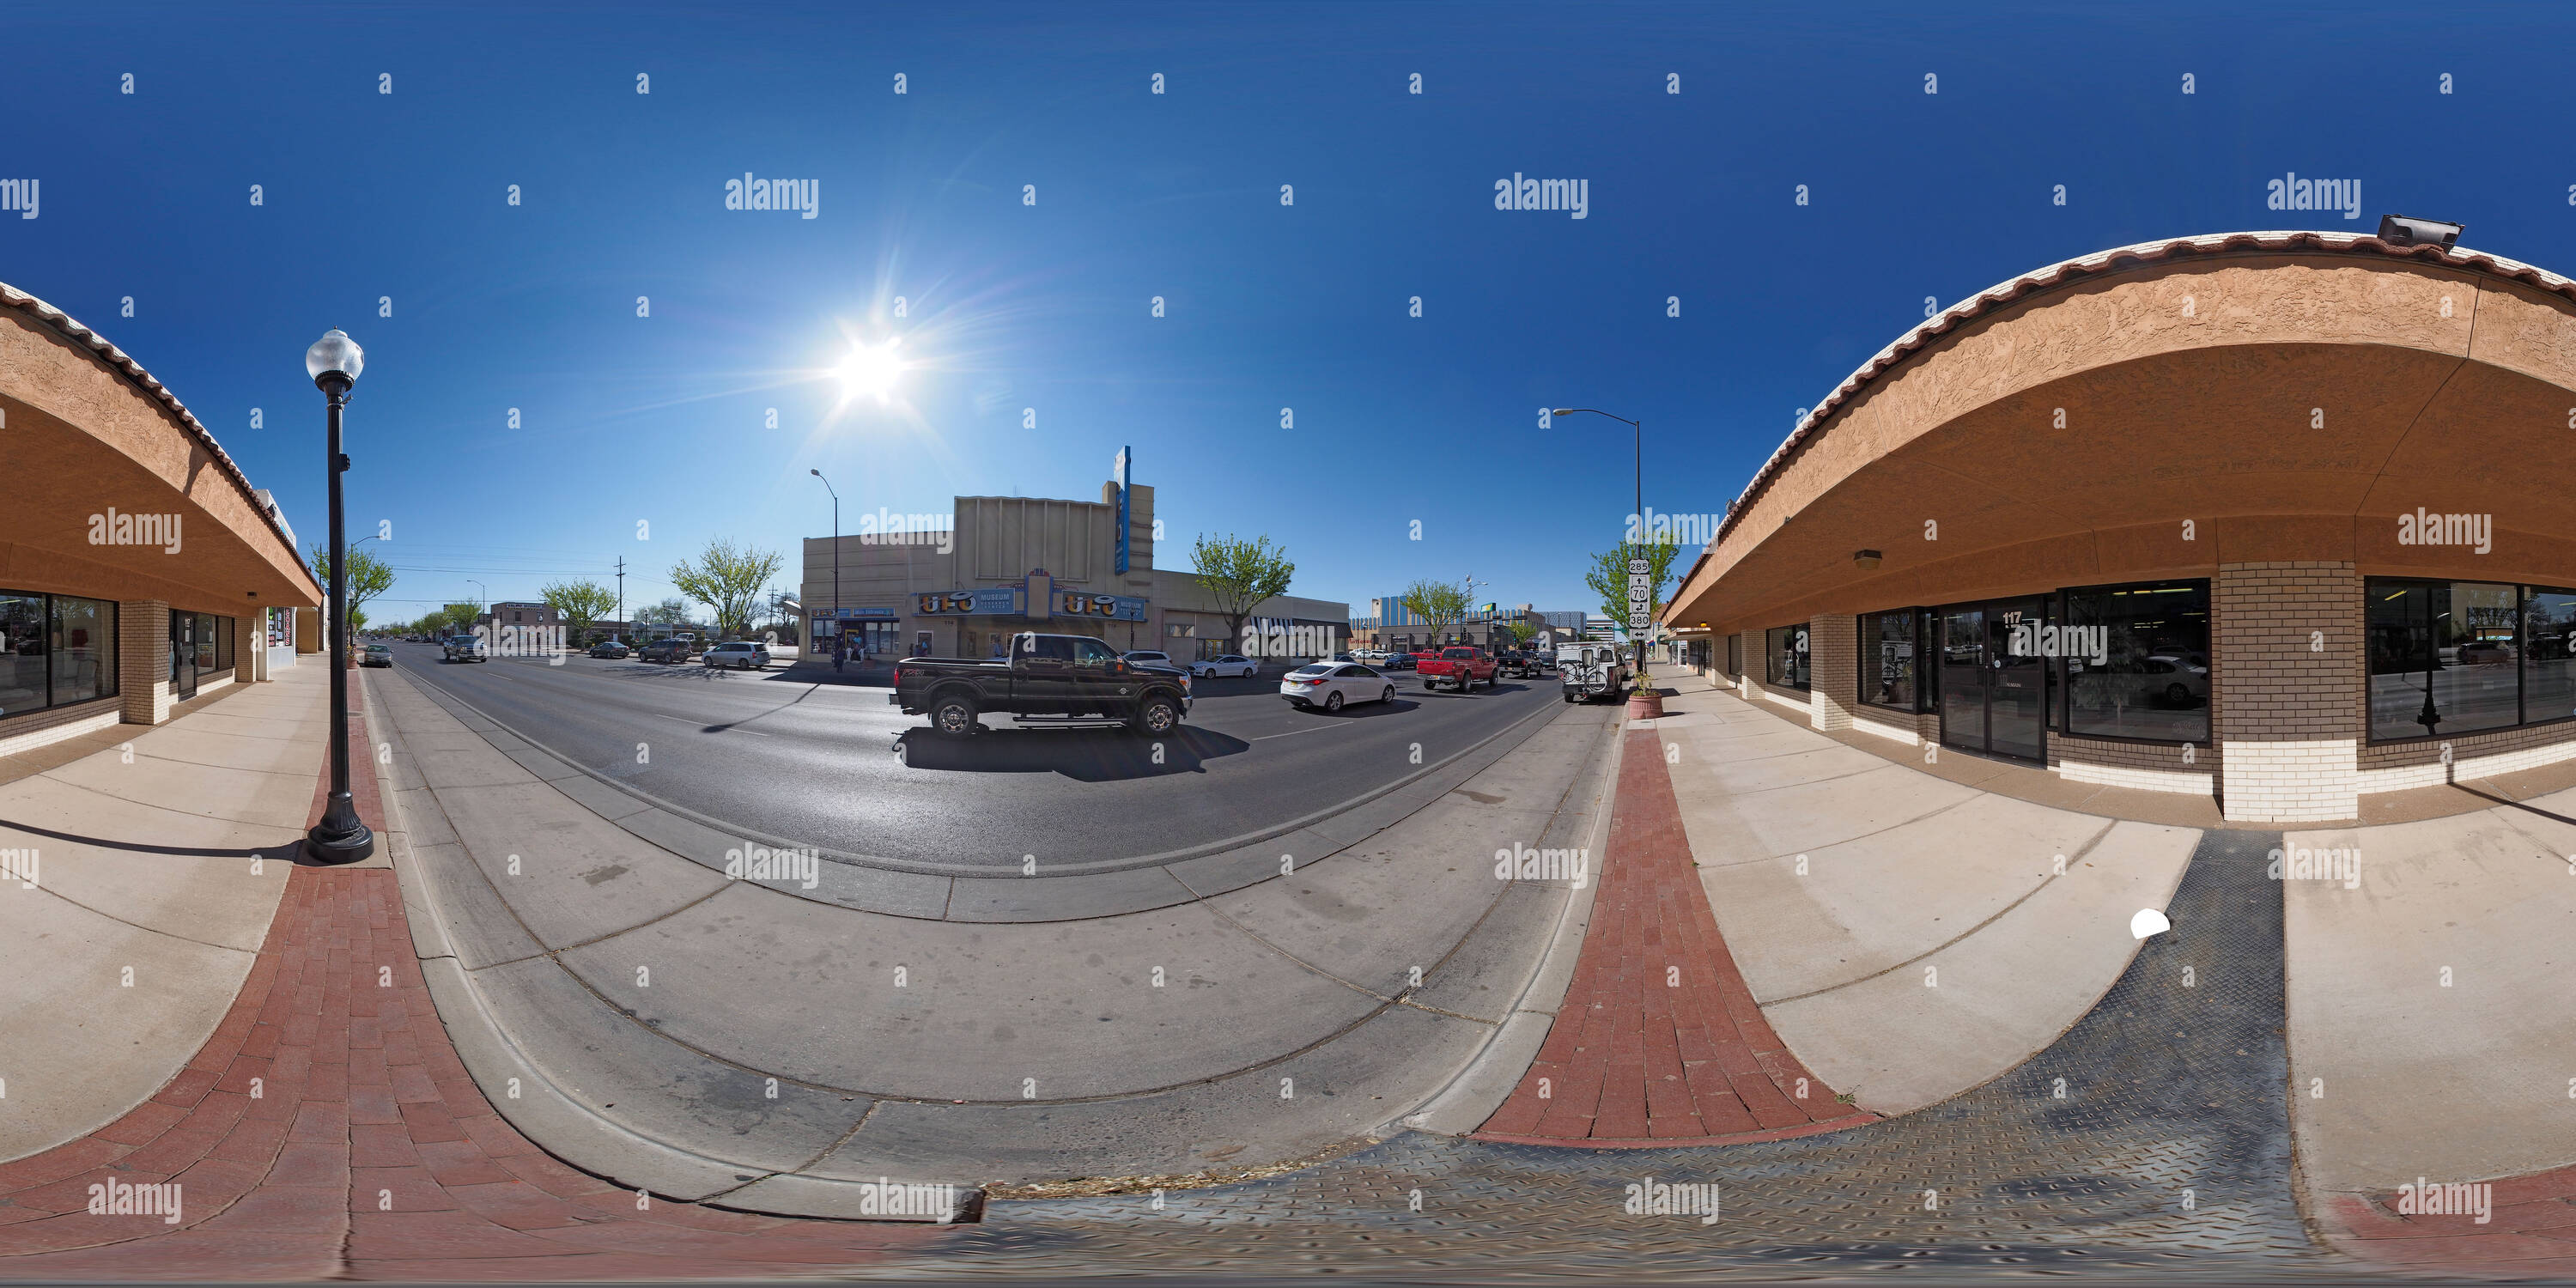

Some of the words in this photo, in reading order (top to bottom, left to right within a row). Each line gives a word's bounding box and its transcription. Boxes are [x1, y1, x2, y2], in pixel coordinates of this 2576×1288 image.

[921, 592, 976, 612] UFO
[1633, 590, 1645, 598] 70
[1065, 595, 1117, 616] UFO
[2002, 611, 2022, 623] 117
